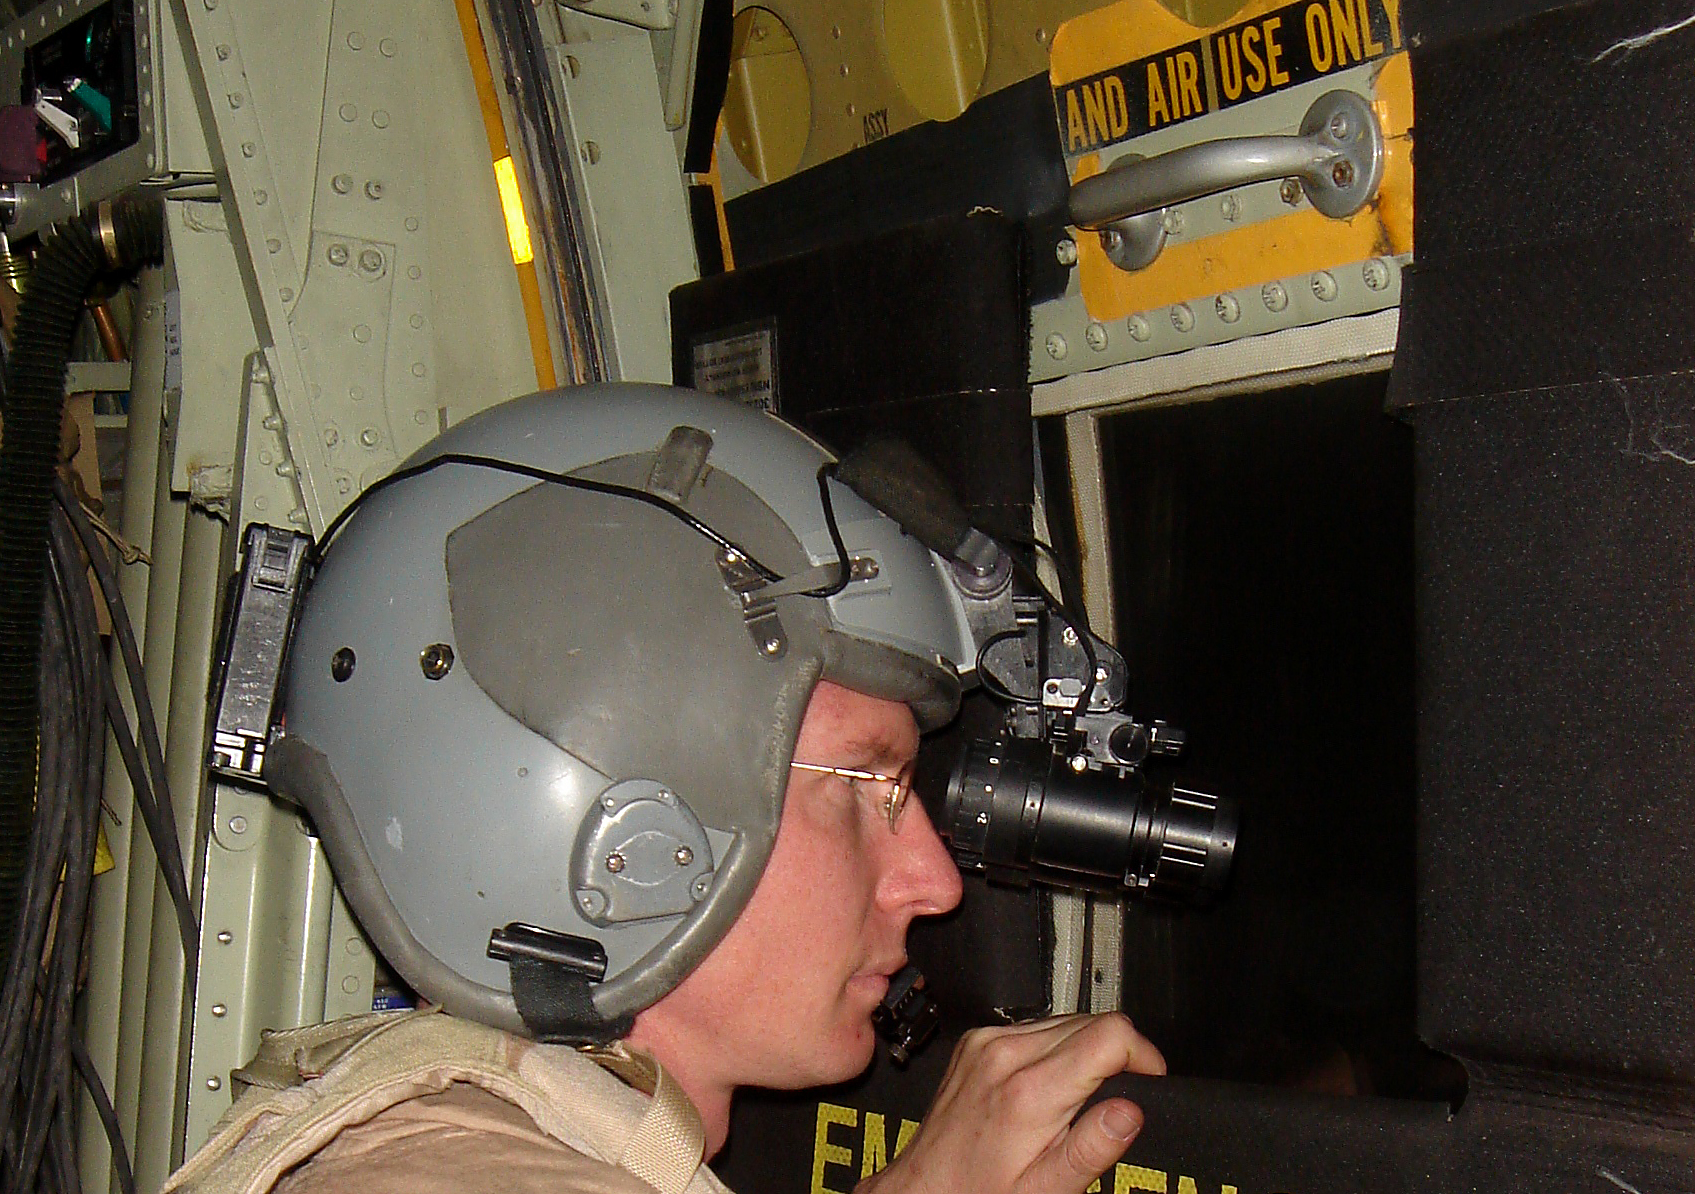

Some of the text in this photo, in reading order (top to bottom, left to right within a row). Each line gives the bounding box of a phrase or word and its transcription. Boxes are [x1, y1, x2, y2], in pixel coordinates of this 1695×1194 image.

[1065, 0, 1401, 152] AND AIR USE ONLY
